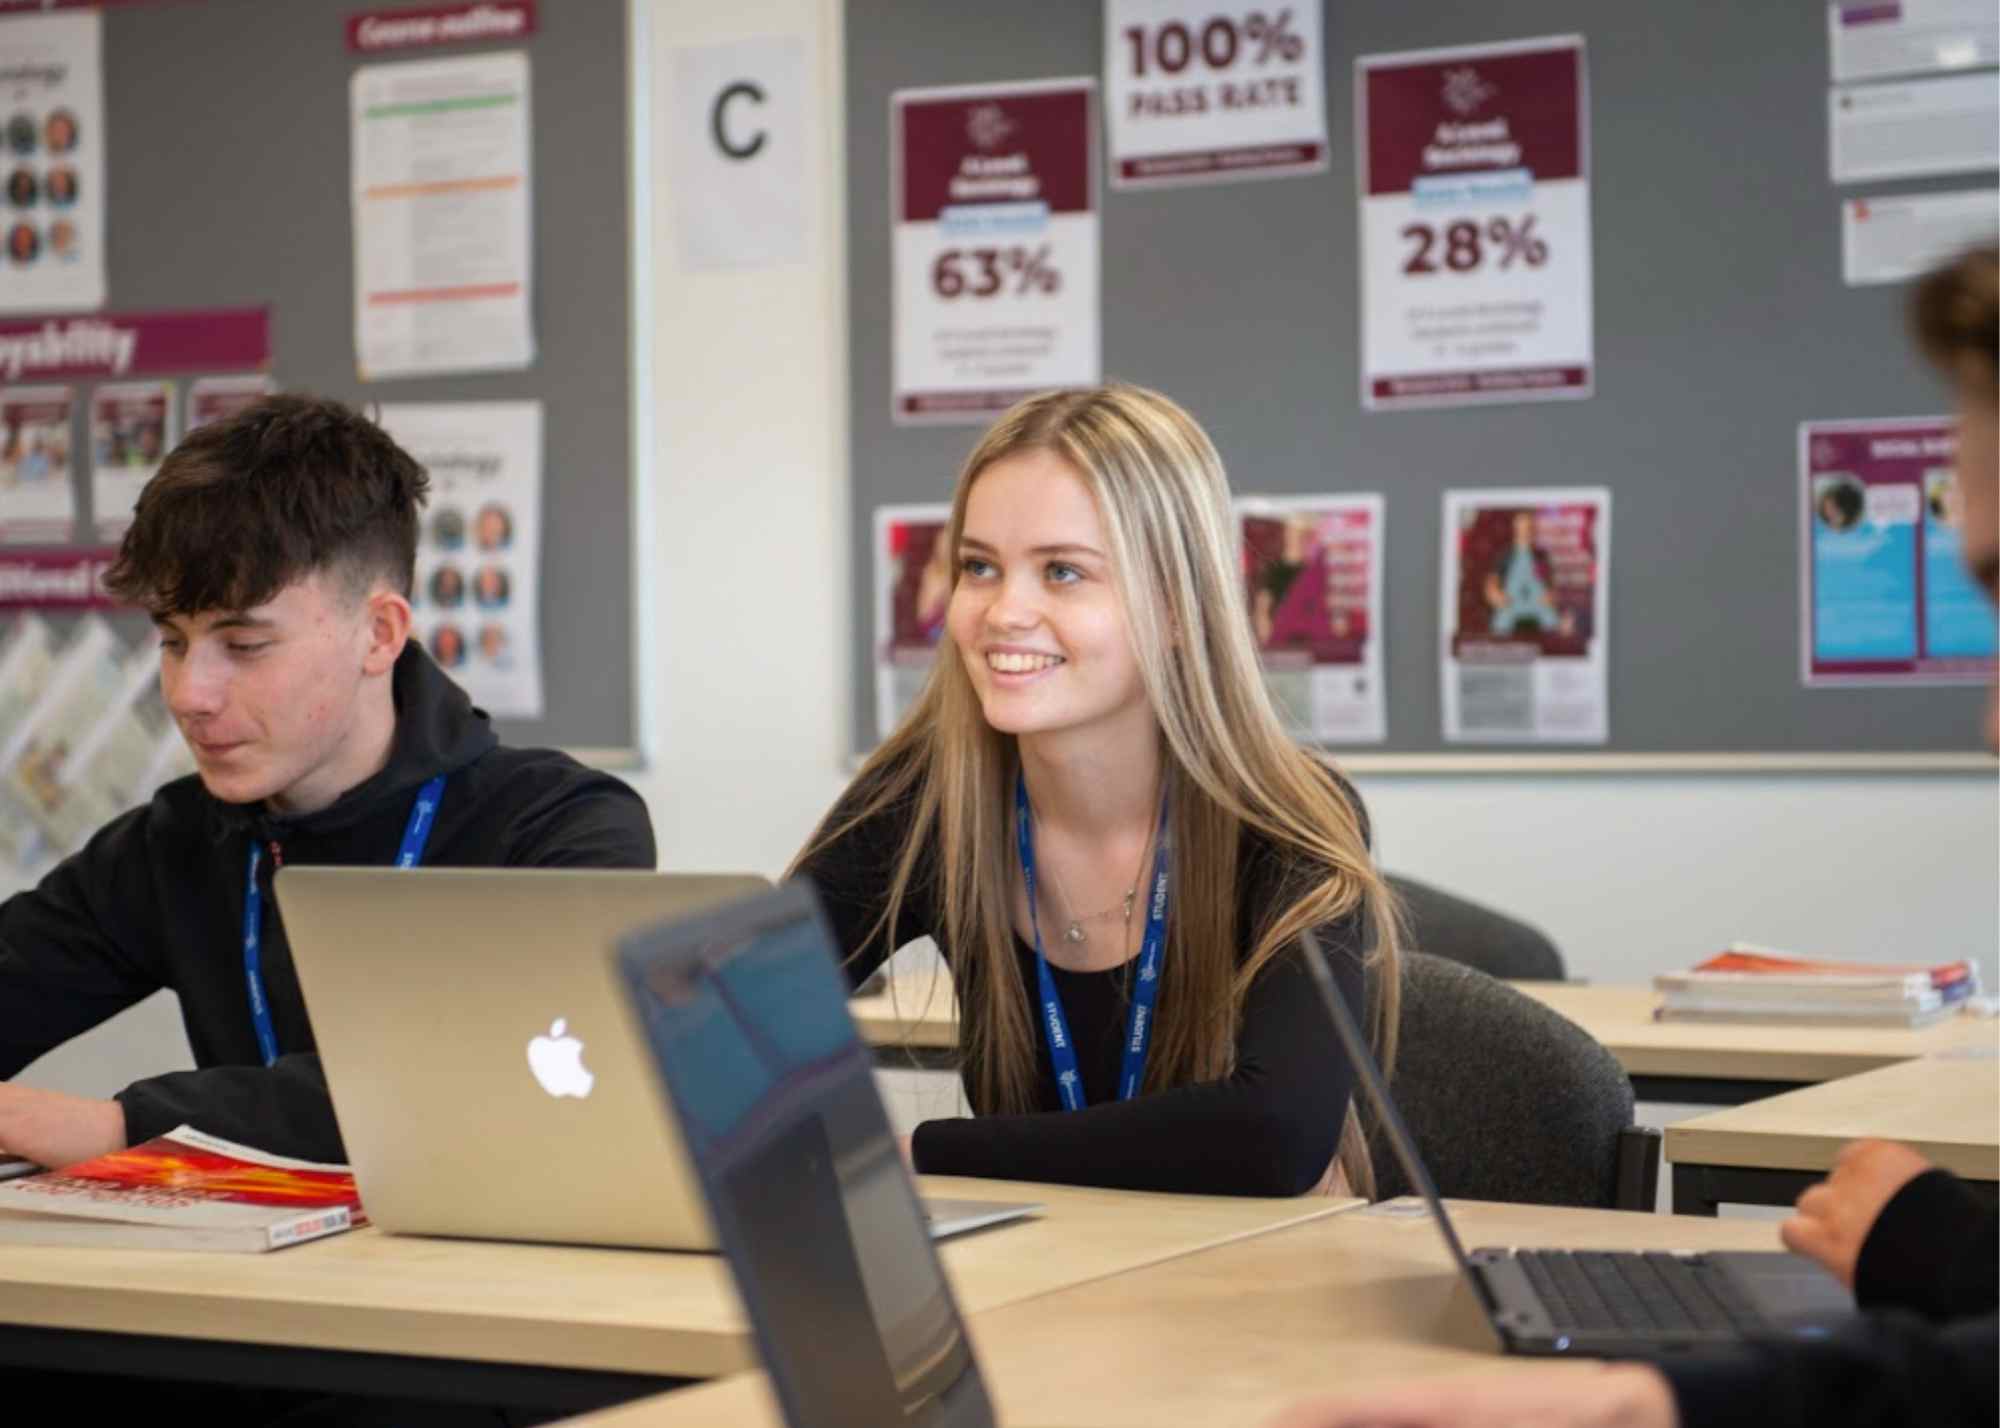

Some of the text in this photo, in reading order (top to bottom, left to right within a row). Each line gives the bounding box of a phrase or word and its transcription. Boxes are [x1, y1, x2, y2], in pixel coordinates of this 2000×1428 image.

[1124, 9, 1305, 77] 100%
[711, 79, 766, 160] C
[1128, 77, 1300, 117] PASS RATE
[1400, 214, 1549, 274] 28%
[932, 243, 1062, 299] 63%
[1153, 871, 1168, 920] STUDENT
[1045, 1001, 1066, 1049] STUDENT
[1131, 1004, 1147, 1053] STUDENT
